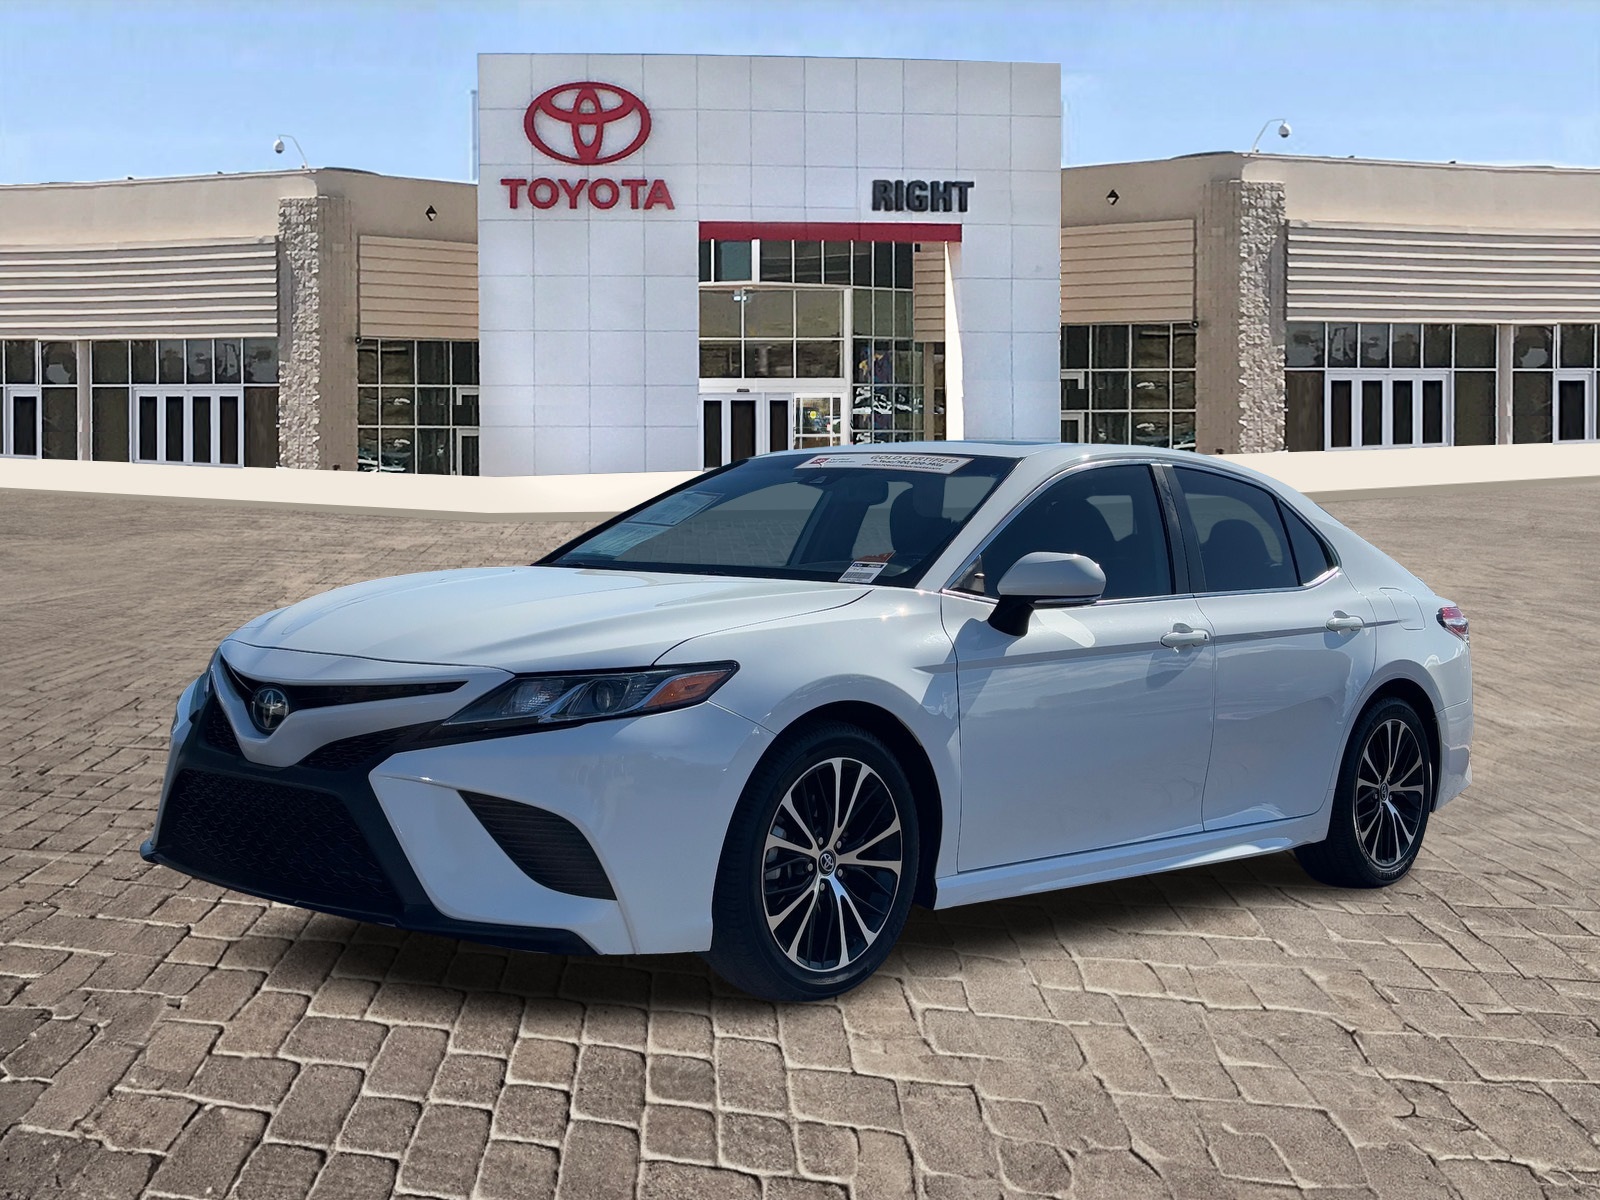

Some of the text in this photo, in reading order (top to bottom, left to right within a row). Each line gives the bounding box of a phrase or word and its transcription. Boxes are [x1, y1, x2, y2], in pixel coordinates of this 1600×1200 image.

[501, 178, 675, 210] TOYOTA
[872, 179, 975, 212] RIGHT
[903, 455, 959, 464] CERTIFIED
